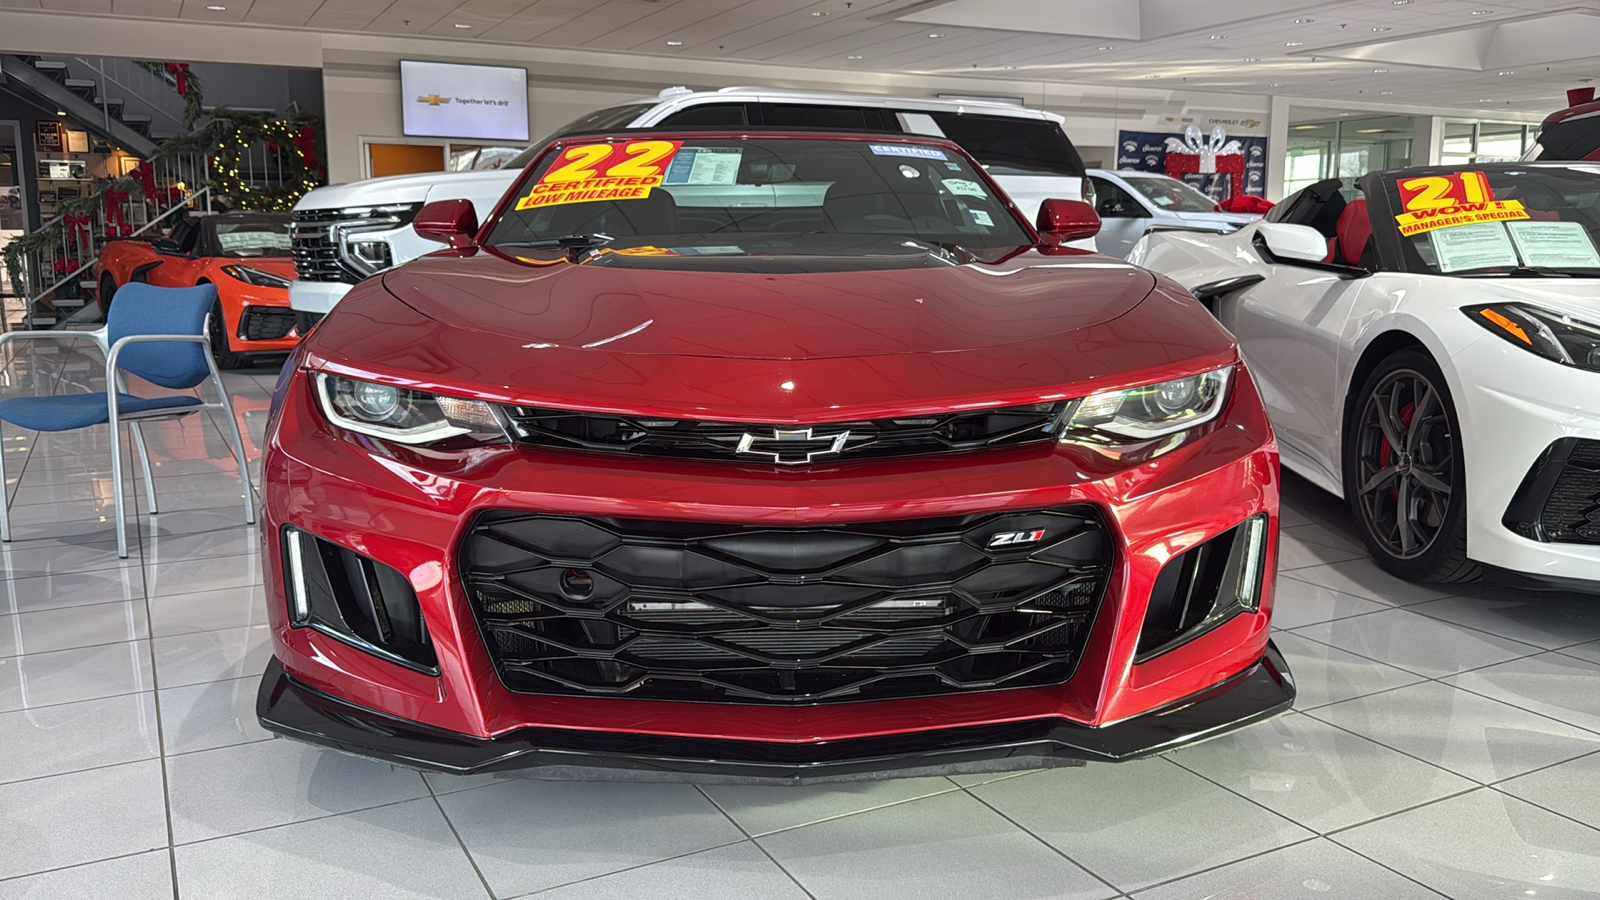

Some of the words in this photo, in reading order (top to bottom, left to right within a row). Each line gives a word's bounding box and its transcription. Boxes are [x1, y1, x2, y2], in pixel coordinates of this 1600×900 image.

[455, 97, 483, 105] Together
[873, 145, 941, 157] CERTIFIED
[543, 140, 675, 183] 22
[532, 176, 659, 194] CERTIFIED
[1402, 172, 1488, 211] 21
[522, 193, 564, 207] LOW
[563, 187, 645, 201] MILEAGE
[1401, 215, 1474, 234] MANAGER'S
[990, 530, 1045, 546] ZL1
